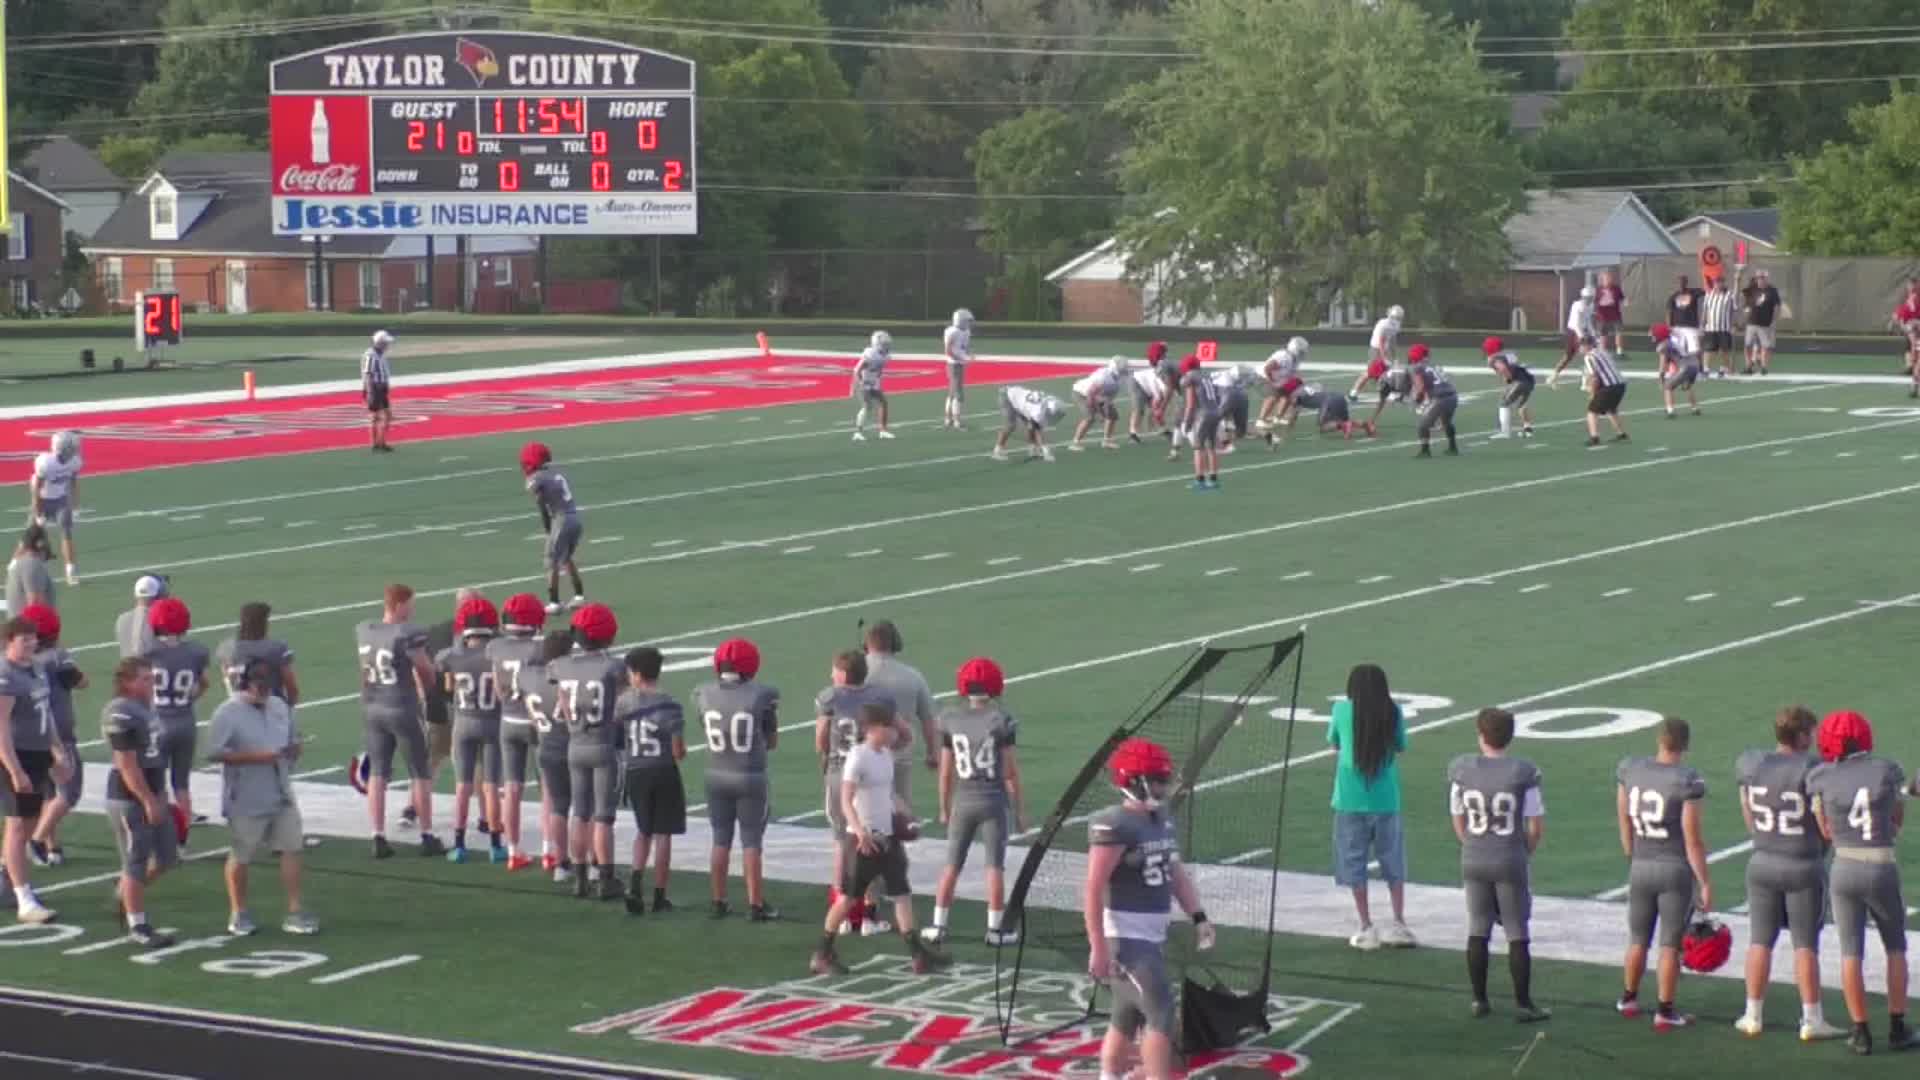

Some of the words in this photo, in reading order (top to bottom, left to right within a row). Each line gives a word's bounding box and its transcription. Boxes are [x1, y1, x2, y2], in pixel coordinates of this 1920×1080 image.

[323, 54, 445, 86] TAYLOR
[508, 54, 640, 85] COUNTY
[391, 102, 457, 118] GUEST
[494, 97, 583, 136] 11:54
[608, 101, 669, 118] HOME
[408, 121, 445, 150] 21
[457, 131, 474, 154] 0
[591, 131, 607, 154] 0
[638, 119, 657, 151] 0
[377, 169, 419, 182] DOWN
[459, 176, 479, 188] GO
[460, 163, 479, 175] TO
[498, 161, 520, 191] 0
[534, 163, 569, 175] BALL
[550, 175, 569, 188] ON
[591, 161, 611, 191] 0
[663, 161, 683, 191] 2
[279, 200, 423, 230] Jessie
[431, 203, 589, 225] INSURANCE
[144, 296, 181, 334] 21
[152, 669, 195, 705] 29
[454, 672, 496, 710] 20
[559, 680, 605, 722] 73
[629, 717, 661, 757] 15
[704, 710, 754, 753] 60
[952, 733, 995, 779] 84
[1629, 786, 1668, 838] 12
[1748, 785, 1805, 835] 52
[1848, 787, 1872, 840] 4
